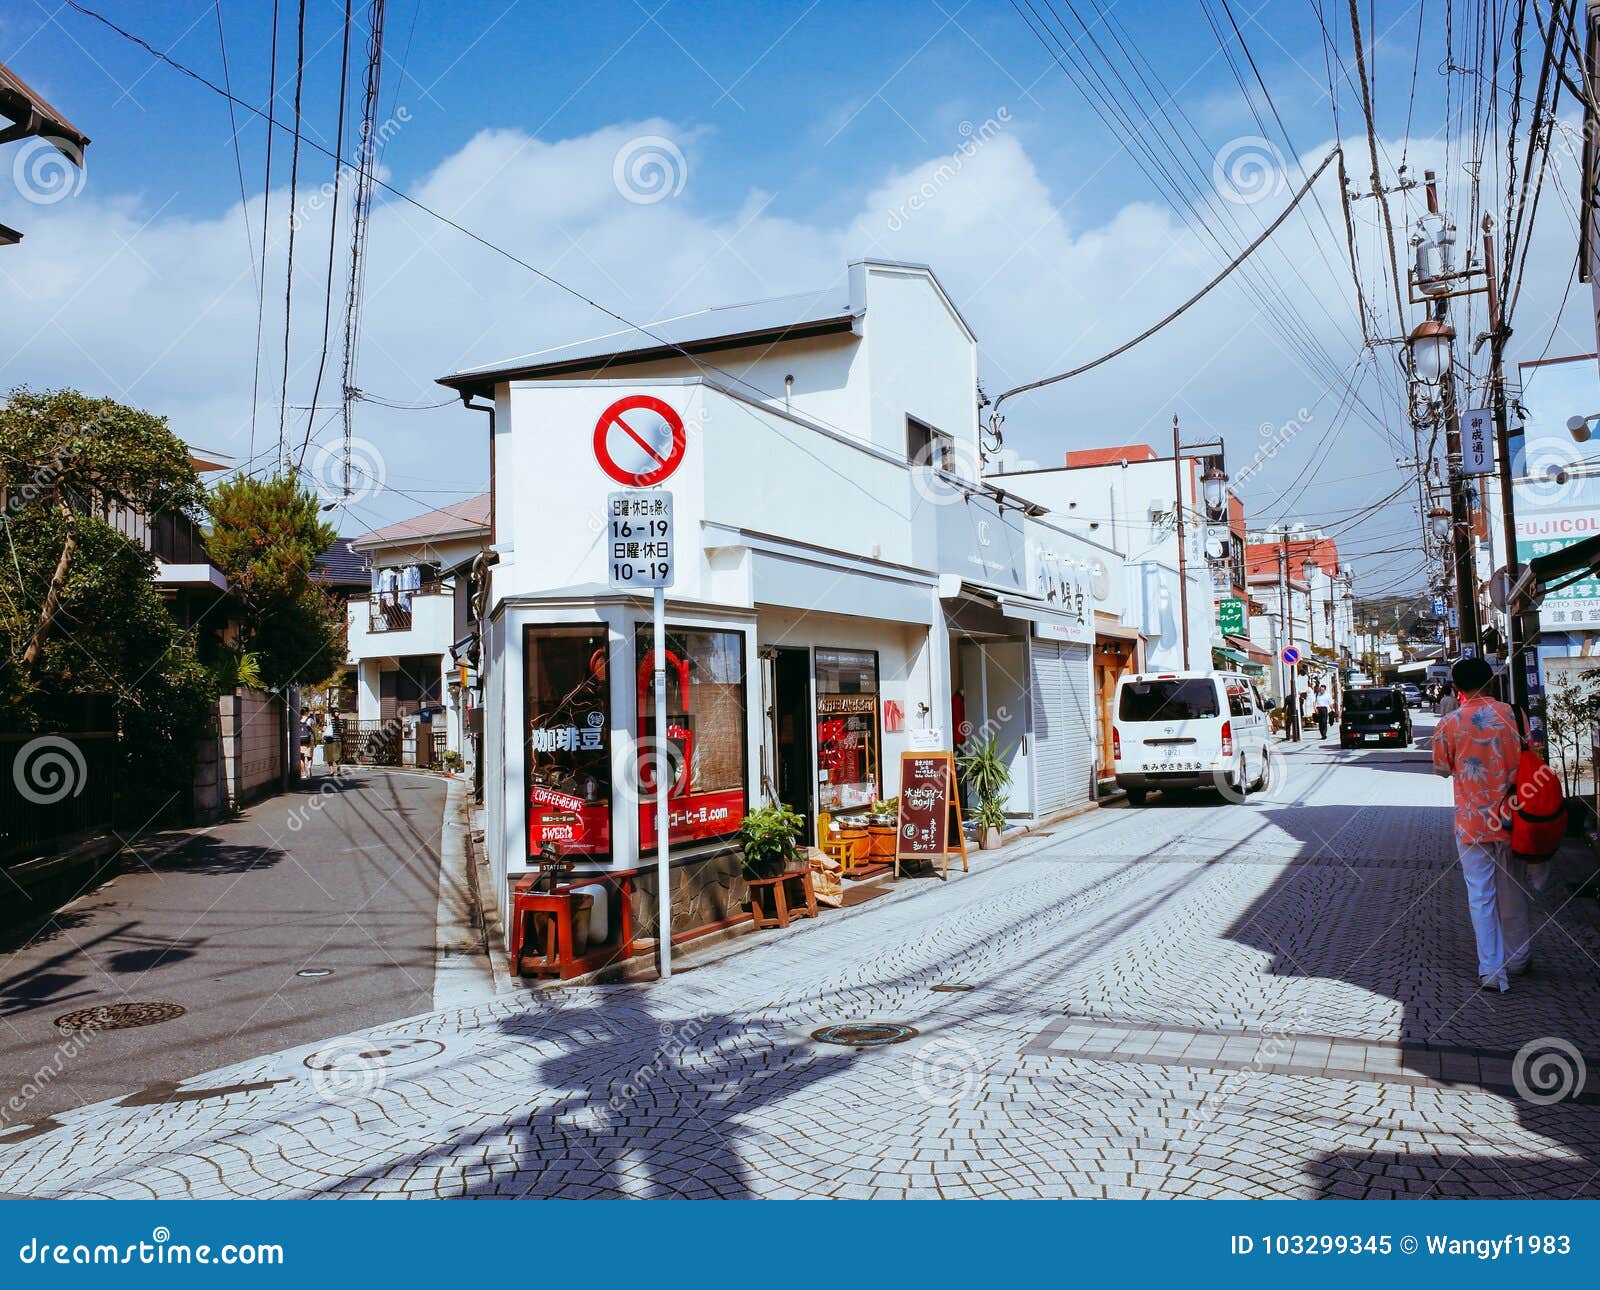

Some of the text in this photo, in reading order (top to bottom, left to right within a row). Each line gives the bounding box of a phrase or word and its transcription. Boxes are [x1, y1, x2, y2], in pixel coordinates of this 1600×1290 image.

[1470, 417, 1485, 466] 御成通り
[613, 499, 668, 516] 日曜・休日を除く
[613, 520, 668, 538] 16-19
[614, 542, 669, 559] 日曜・休日
[613, 562, 669, 580] 10-19
[532, 727, 603, 752] 珈琲豆
